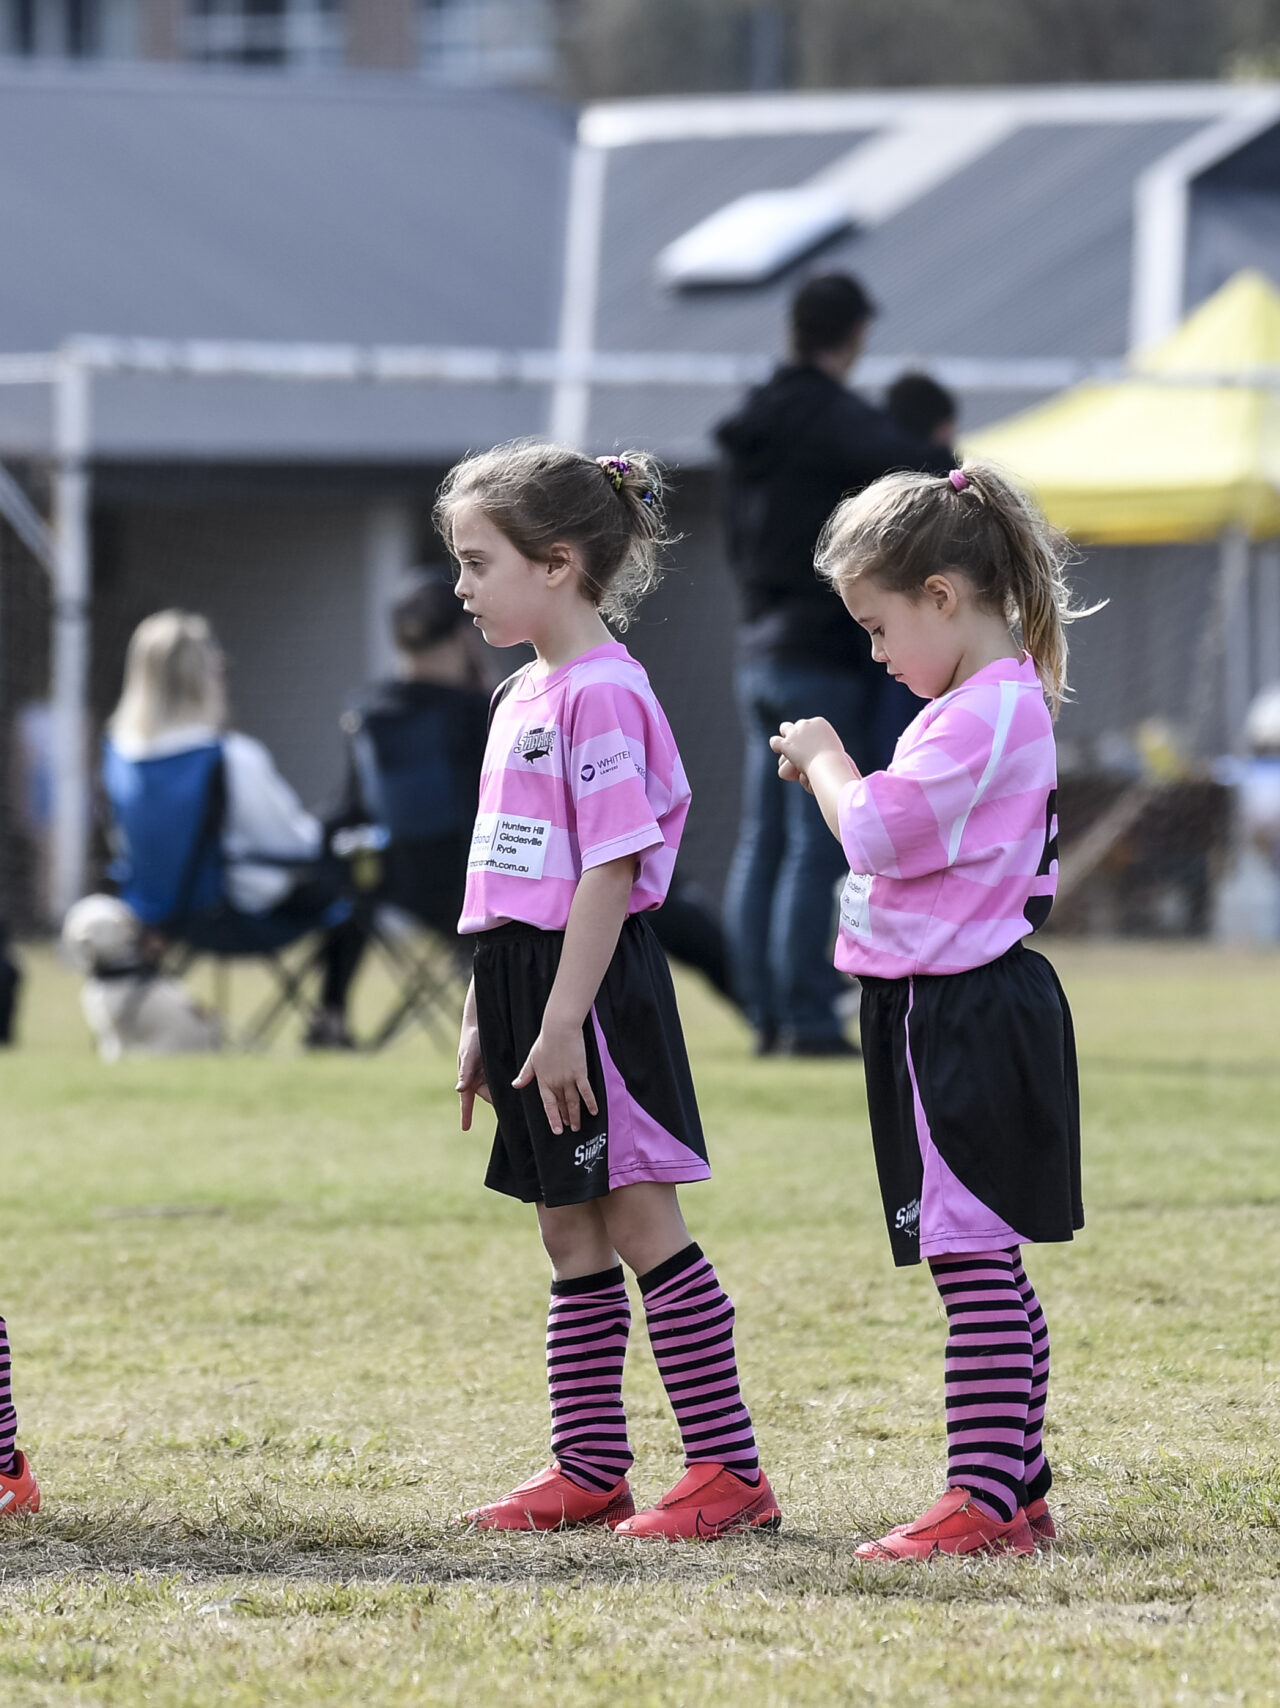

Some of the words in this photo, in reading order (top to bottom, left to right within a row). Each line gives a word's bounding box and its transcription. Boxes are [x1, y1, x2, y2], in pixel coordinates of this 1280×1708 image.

[502, 821, 532, 833] Hunters
[499, 832, 543, 847] Gladesville
[496, 844, 517, 854] Ryde
